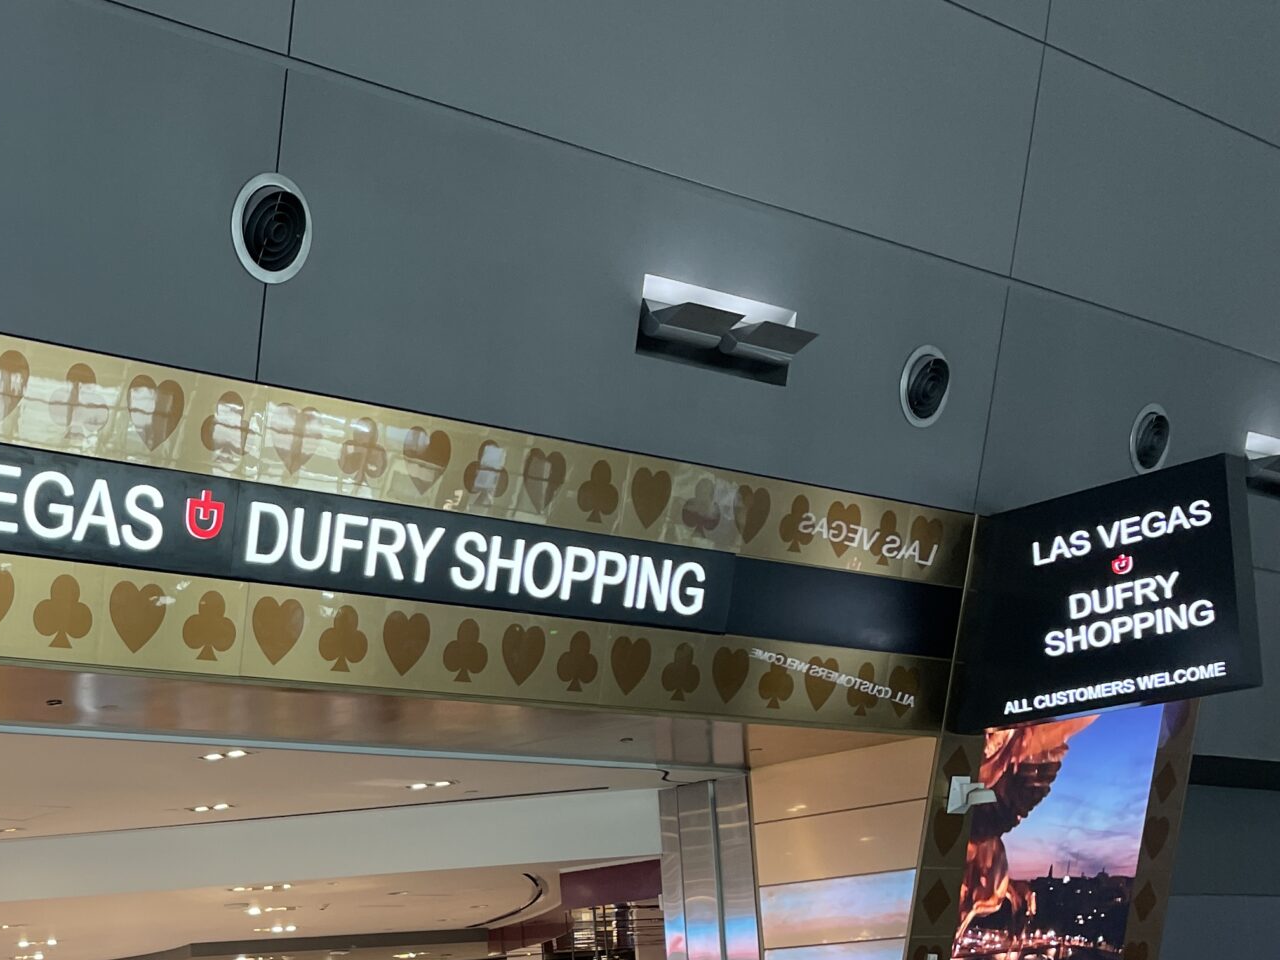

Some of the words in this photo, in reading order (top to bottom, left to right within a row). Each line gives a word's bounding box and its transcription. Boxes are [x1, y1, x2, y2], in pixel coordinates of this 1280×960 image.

[244, 500, 446, 583] DUFRY
[449, 531, 707, 616] SHOPPING
[1031, 529, 1092, 567] LAS
[1096, 499, 1212, 549] VEGAS
[1068, 570, 1180, 620] DUFRY
[1044, 599, 1216, 657] SHOPPING
[1003, 698, 1032, 715] ALL
[1033, 678, 1135, 710] CUSTOMERS
[1136, 661, 1227, 691] WELCOME
